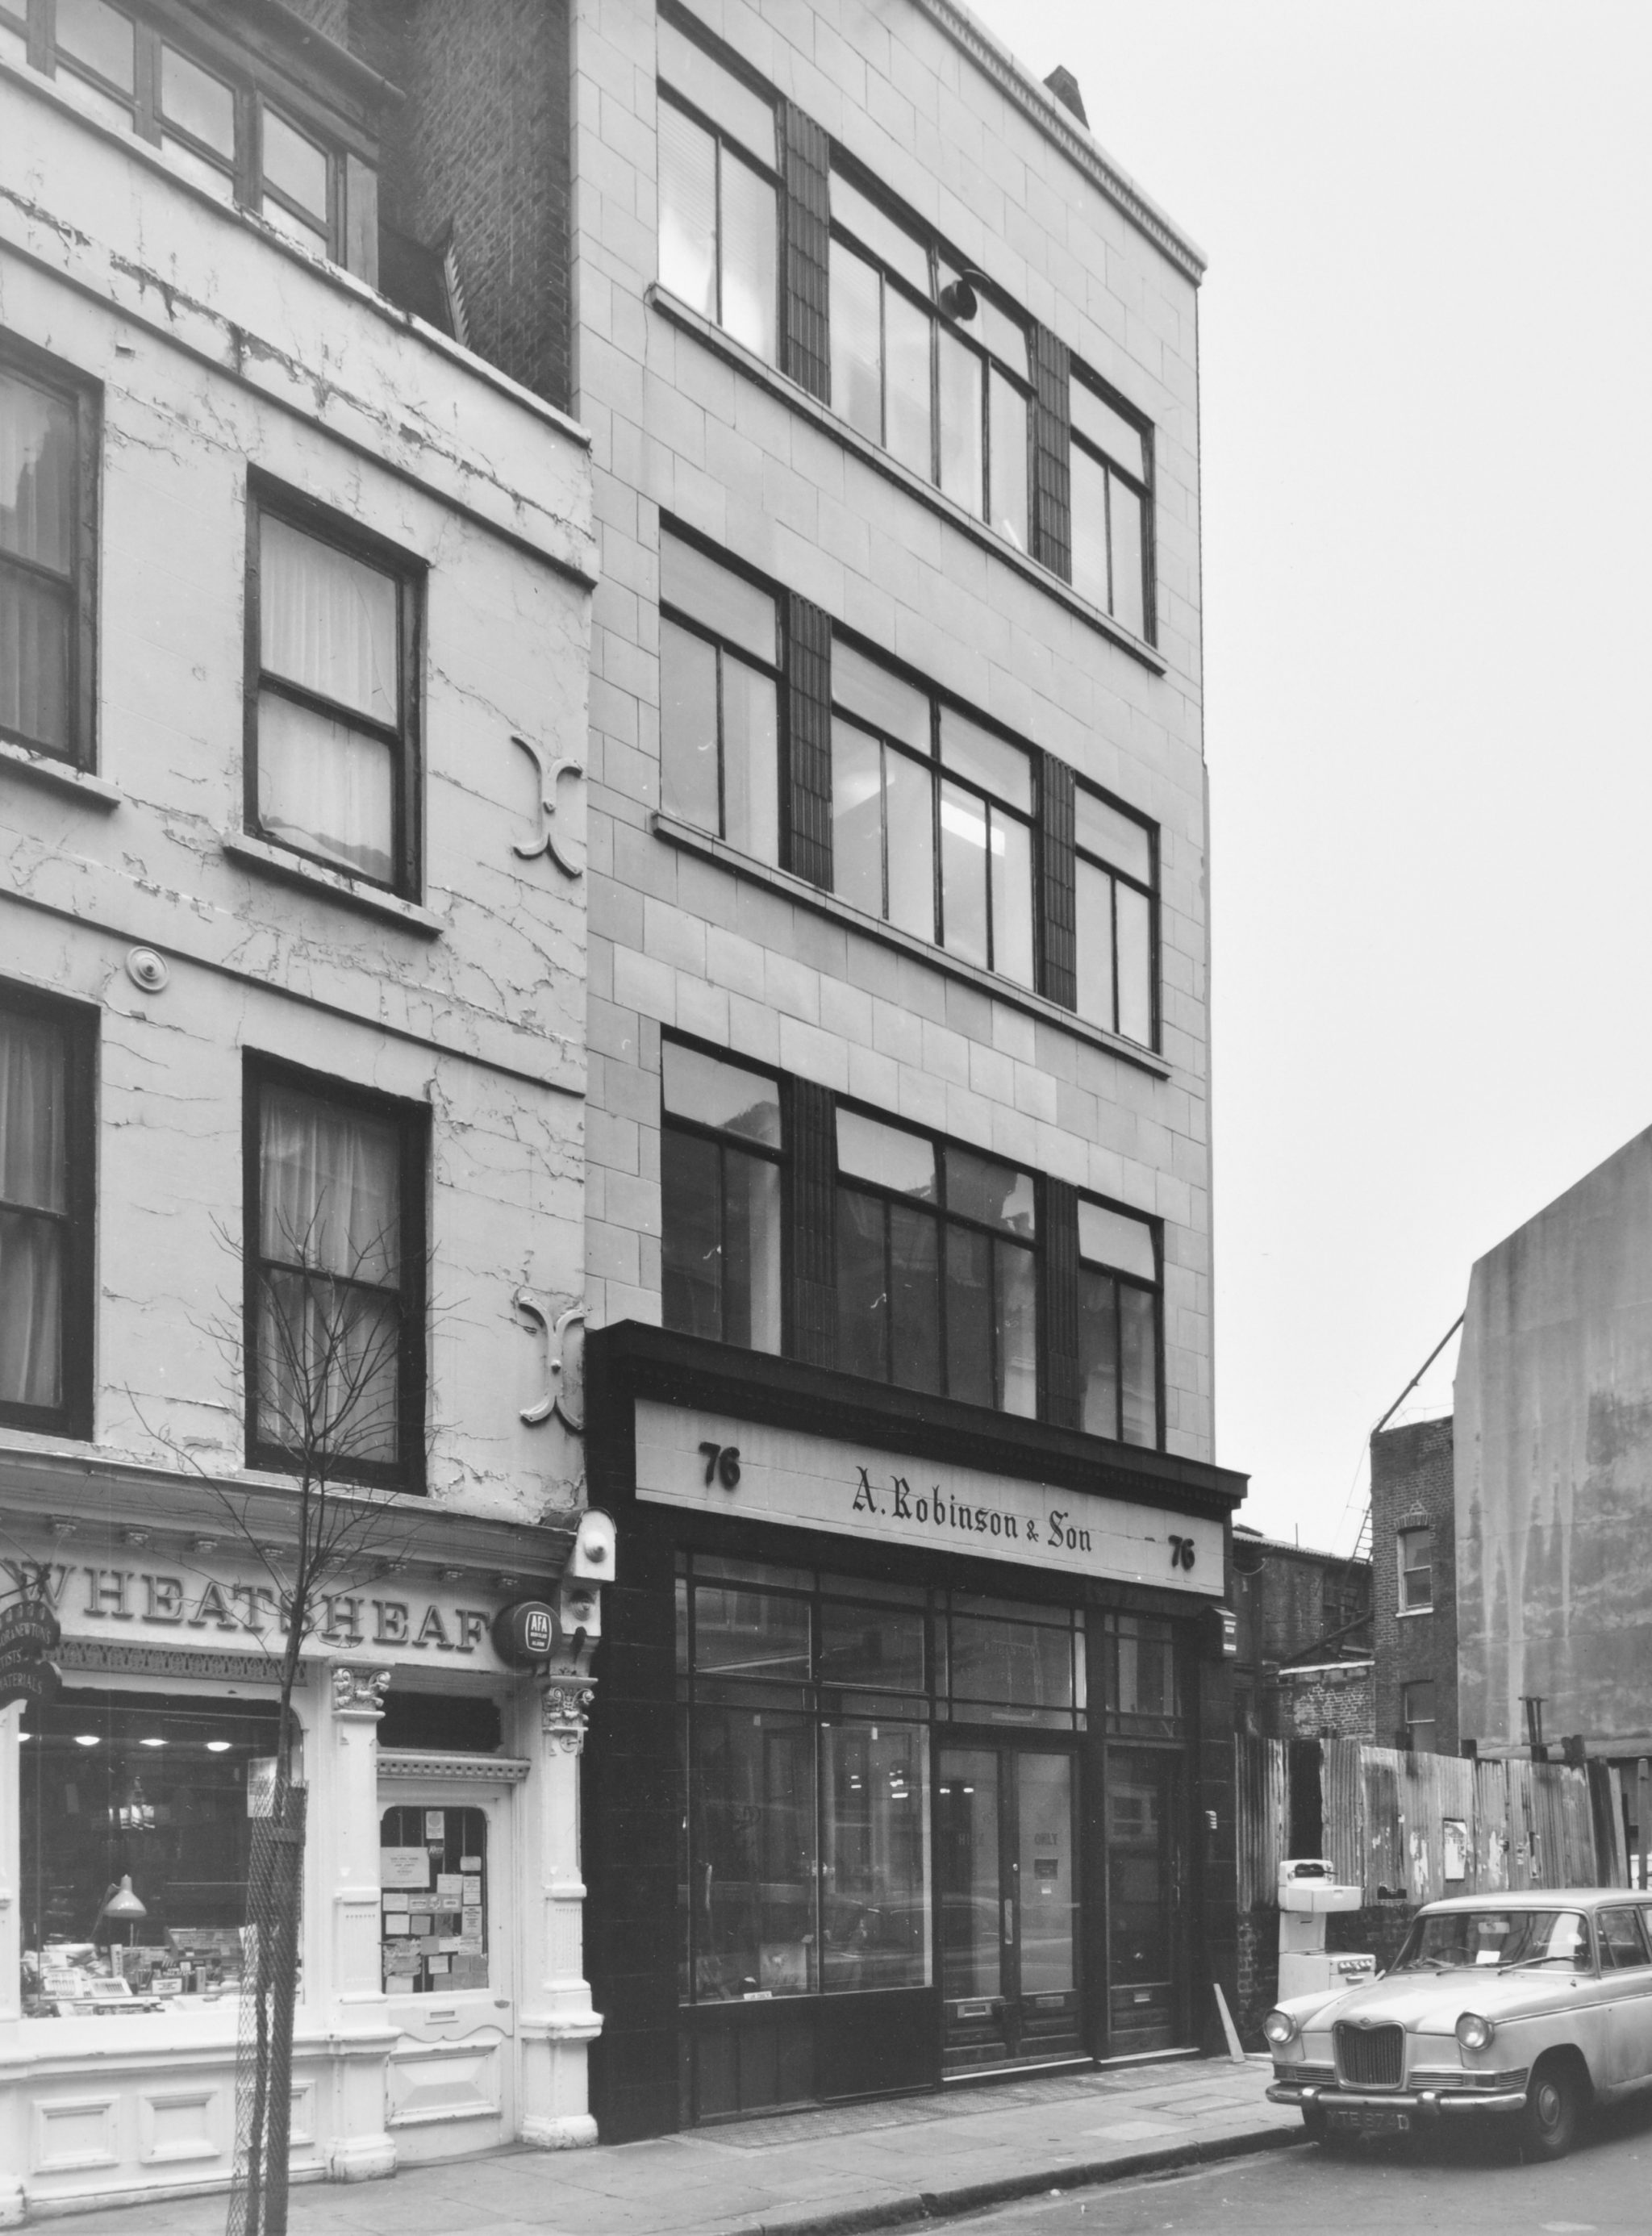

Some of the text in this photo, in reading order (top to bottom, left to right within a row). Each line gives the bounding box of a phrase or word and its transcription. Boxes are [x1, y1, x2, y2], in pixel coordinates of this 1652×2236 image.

[699, 1440, 740, 1491] 76
[890, 1475, 1018, 1539] Robinson
[1025, 1519, 1039, 1542] &
[1047, 1509, 1091, 1553] Son
[1167, 1534, 1195, 1571] 76
[2, 1557, 494, 1654] WHEATSHEAF
[531, 1614, 548, 1633] AFA
